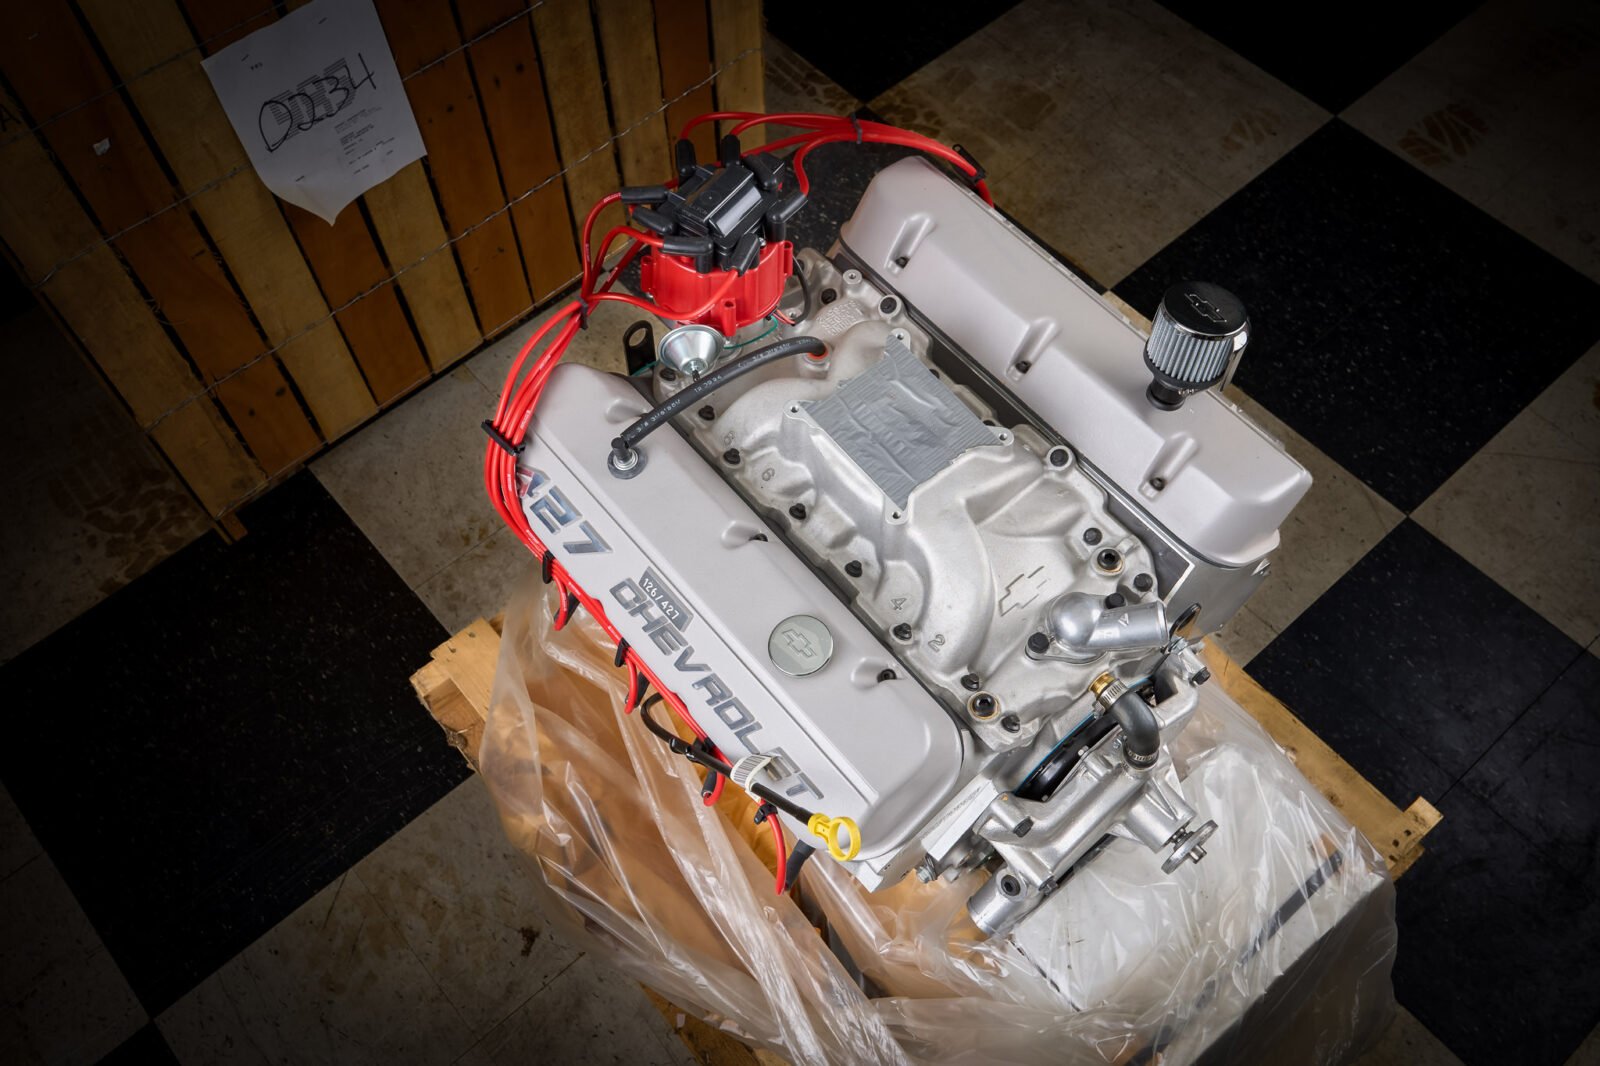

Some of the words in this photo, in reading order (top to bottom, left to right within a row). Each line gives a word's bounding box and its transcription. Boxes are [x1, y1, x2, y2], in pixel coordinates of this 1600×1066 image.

[890, 597, 908, 611] 4
[928, 634, 946, 653] 2
[609, 577, 825, 800] CHEVROLET
